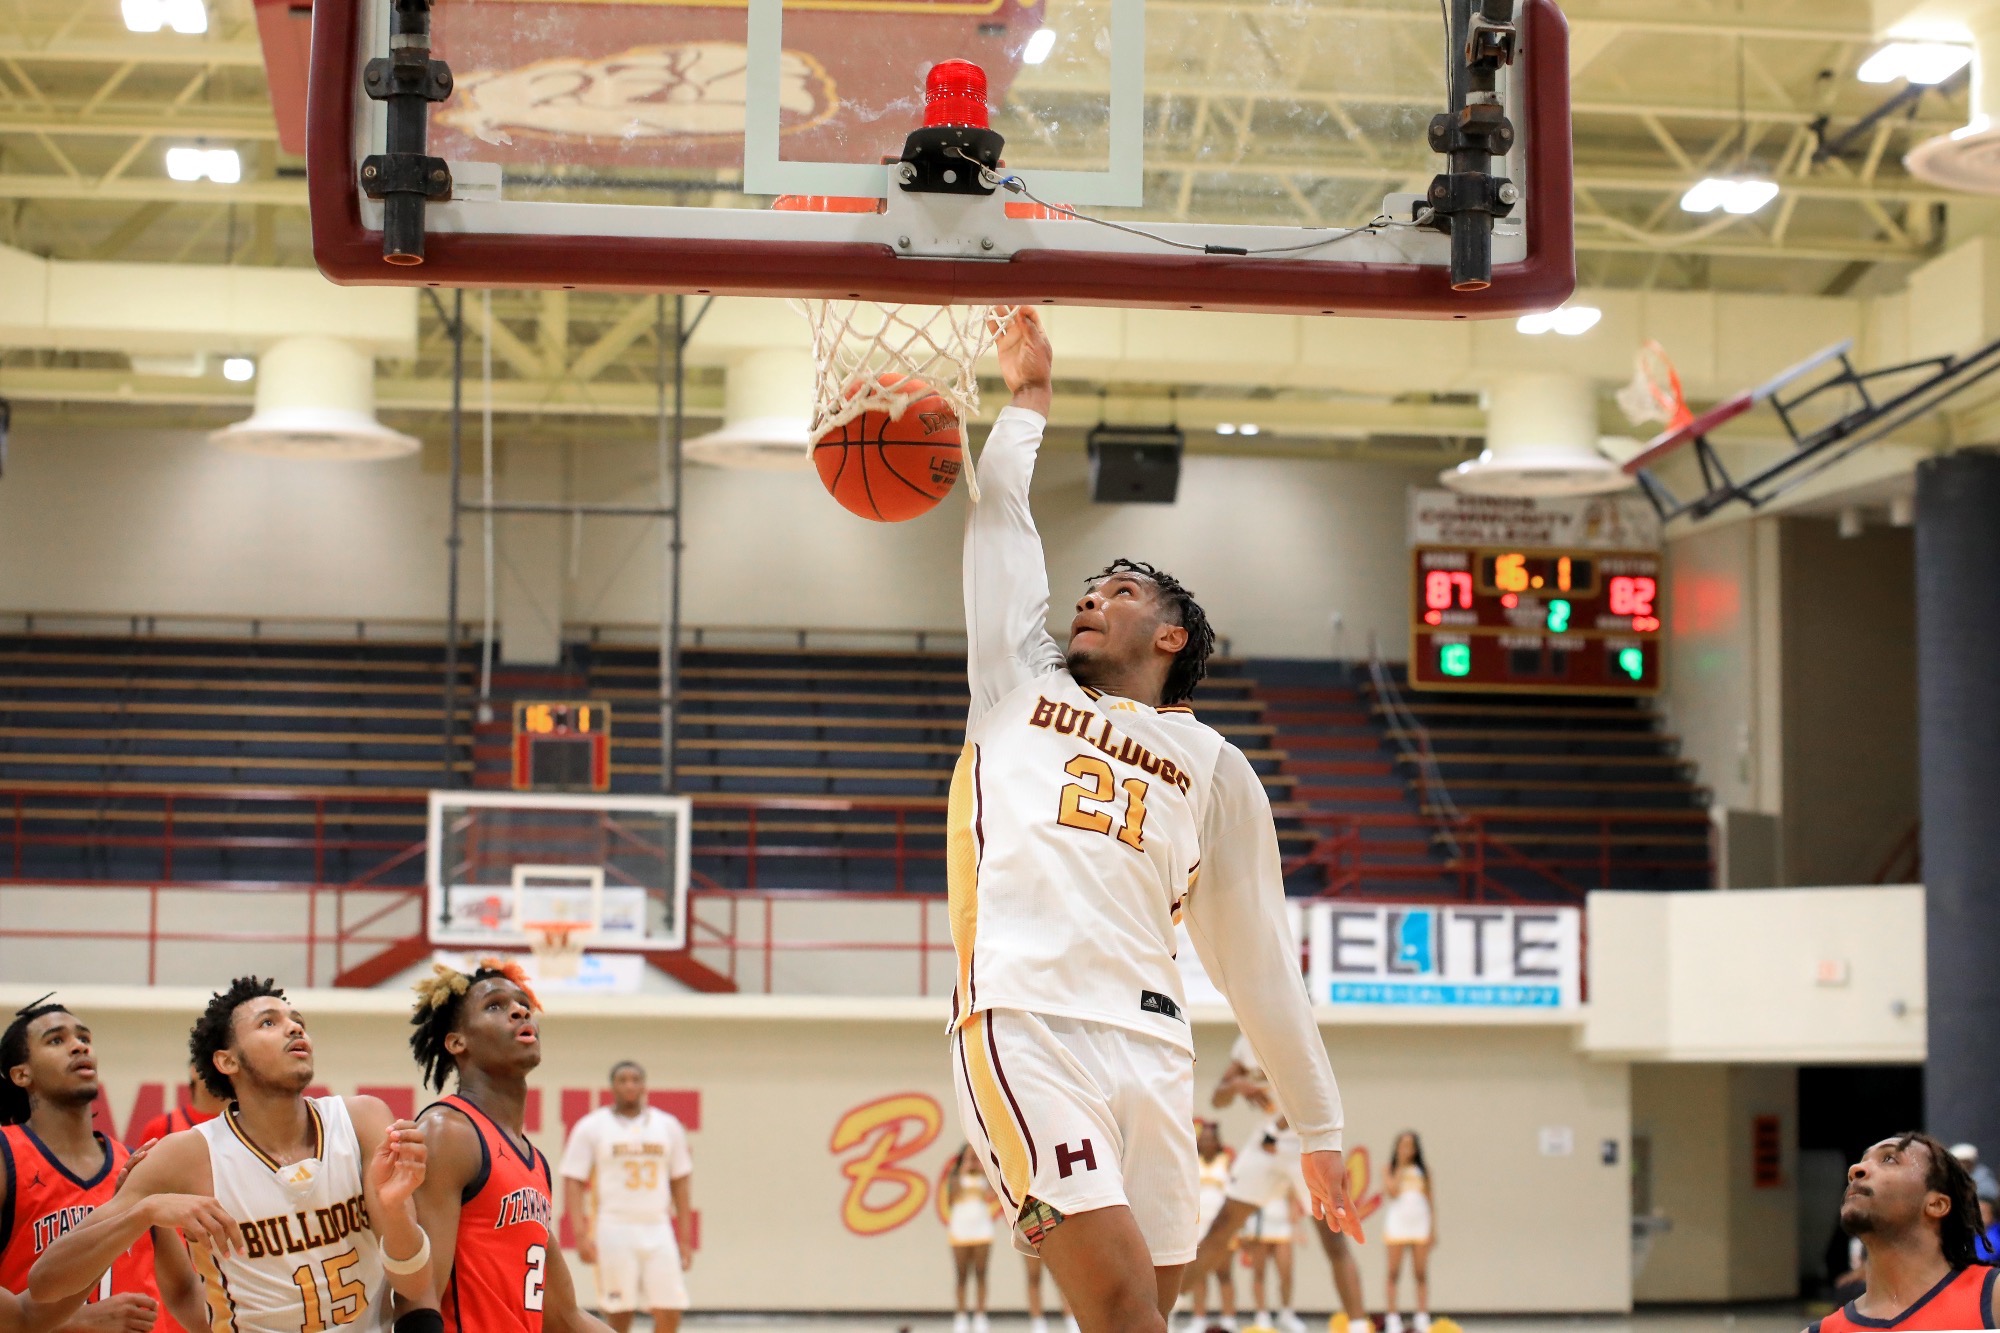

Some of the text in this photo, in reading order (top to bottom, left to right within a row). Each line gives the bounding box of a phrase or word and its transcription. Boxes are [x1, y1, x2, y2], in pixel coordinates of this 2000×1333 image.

[1425, 571, 1472, 609] 87
[1610, 576, 1656, 615] 82
[1028, 695, 1193, 797] BULLDOGS
[1056, 753, 1151, 853] 21
[1331, 911, 1560, 976] ELITE
[1335, 984, 1558, 1005] PHYSICAL THERAPY
[624, 1161, 658, 1190] 33
[1054, 1138, 1098, 1179] H
[238, 1194, 371, 1259] BULLDOGS
[292, 1247, 369, 1333] 15
[524, 1243, 547, 1312] 2
